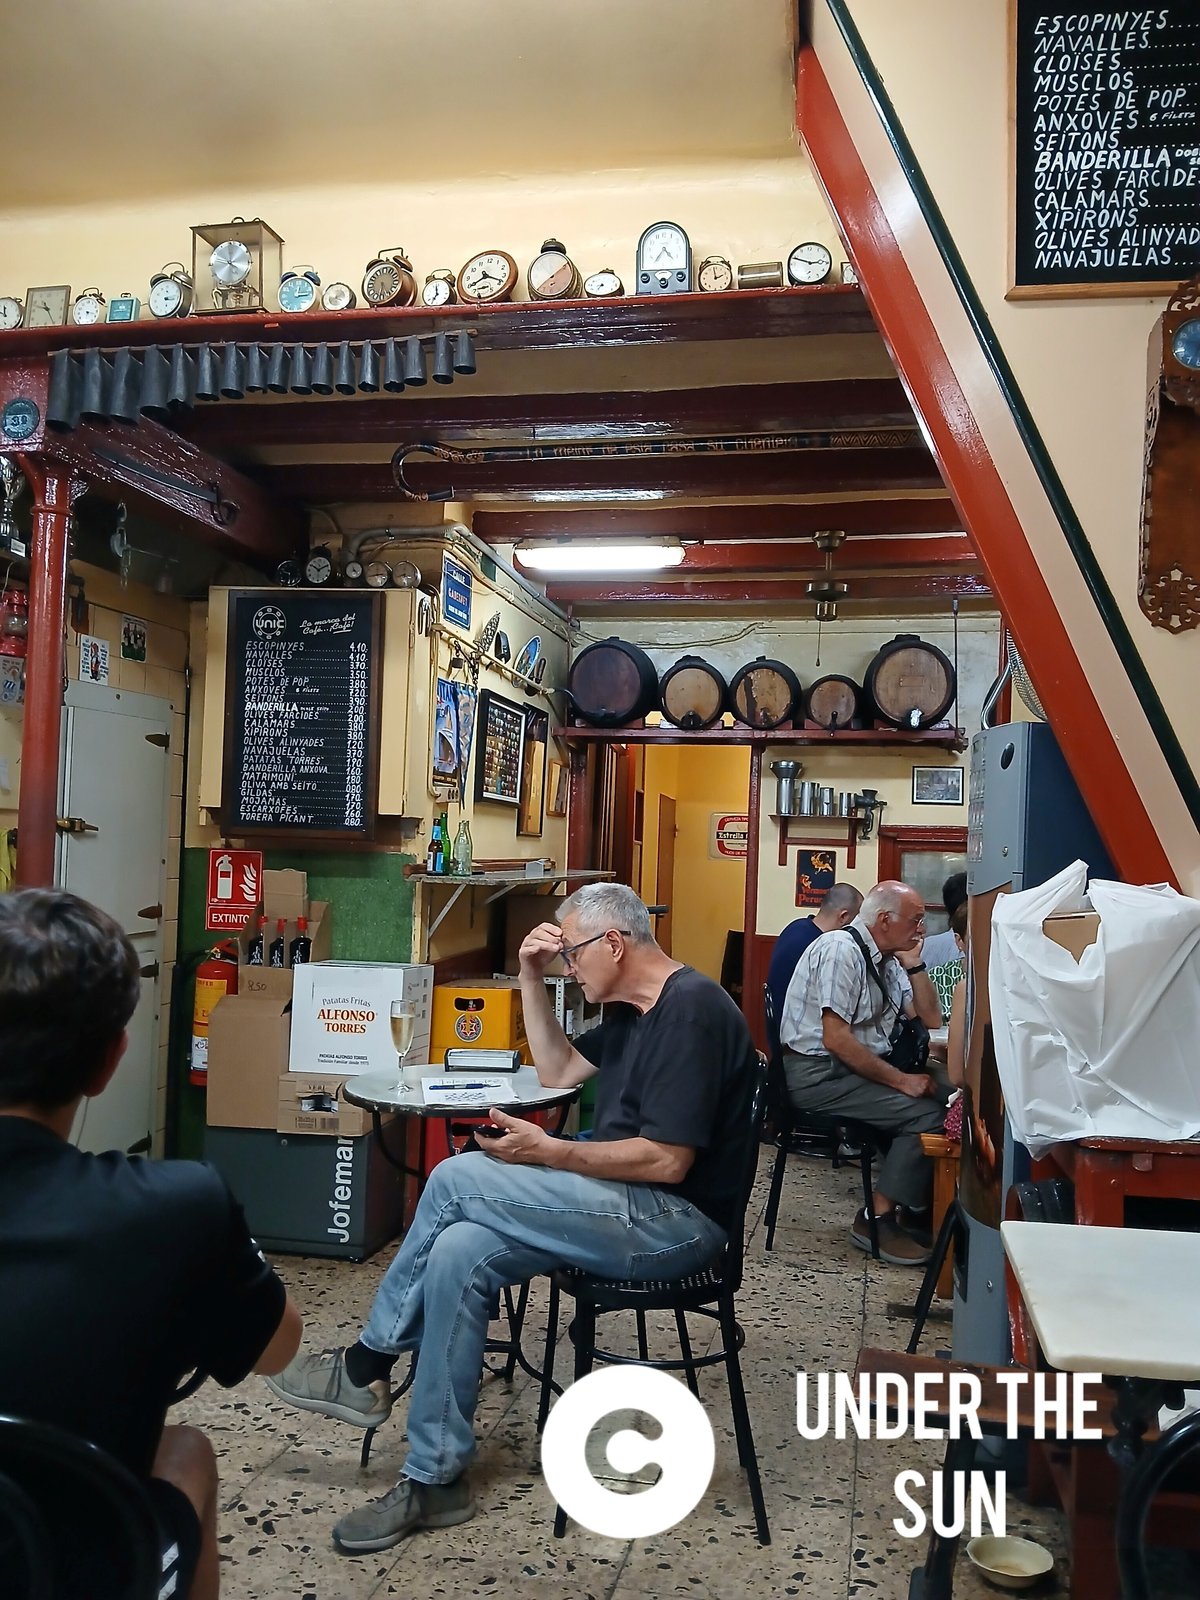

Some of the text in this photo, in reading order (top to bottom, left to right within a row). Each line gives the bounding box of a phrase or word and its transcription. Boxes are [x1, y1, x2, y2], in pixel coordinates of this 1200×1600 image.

[1034, 10, 1169, 35] ESCOPINYES
[1034, 31, 1149, 54] NAVALLES
[1033, 71, 1134, 93] MUSCLOS
[1033, 88, 1187, 112] POTES DE POP
[1033, 110, 1139, 132] ANXOVES
[1149, 113, 1158, 121] 6
[1034, 148, 1171, 173] BANDERILLA
[1114, 167, 1200, 189] FARCIDE
[1034, 189, 1149, 211] CALAMARS
[1034, 247, 1172, 269] NAVAJUELAS
[245, 641, 305, 651] ESCOPINYES
[245, 651, 293, 660] NAVALLES
[245, 667, 286, 677] MUSCLOS
[244, 677, 275, 686] POTES
[280, 677, 289, 686] DE
[292, 677, 309, 687] POP
[244, 686, 286, 694] ANXOVES
[244, 702, 299, 712] BANDERILLA
[244, 720, 296, 729] CALAMARS
[243, 746, 306, 756] NAVAJUELAS
[243, 755, 282, 764] PATATAS
[242, 764, 297, 773] BANDERILLA
[270, 781, 289, 790] AMB
[241, 796, 287, 806] MOJAMAS
[240, 804, 298, 815] ESCARXOFES
[322, 997, 371, 1007] Patatas Fritas
[317, 1008, 375, 1022] ALFONSO
[324, 1022, 367, 1034] TORRES
